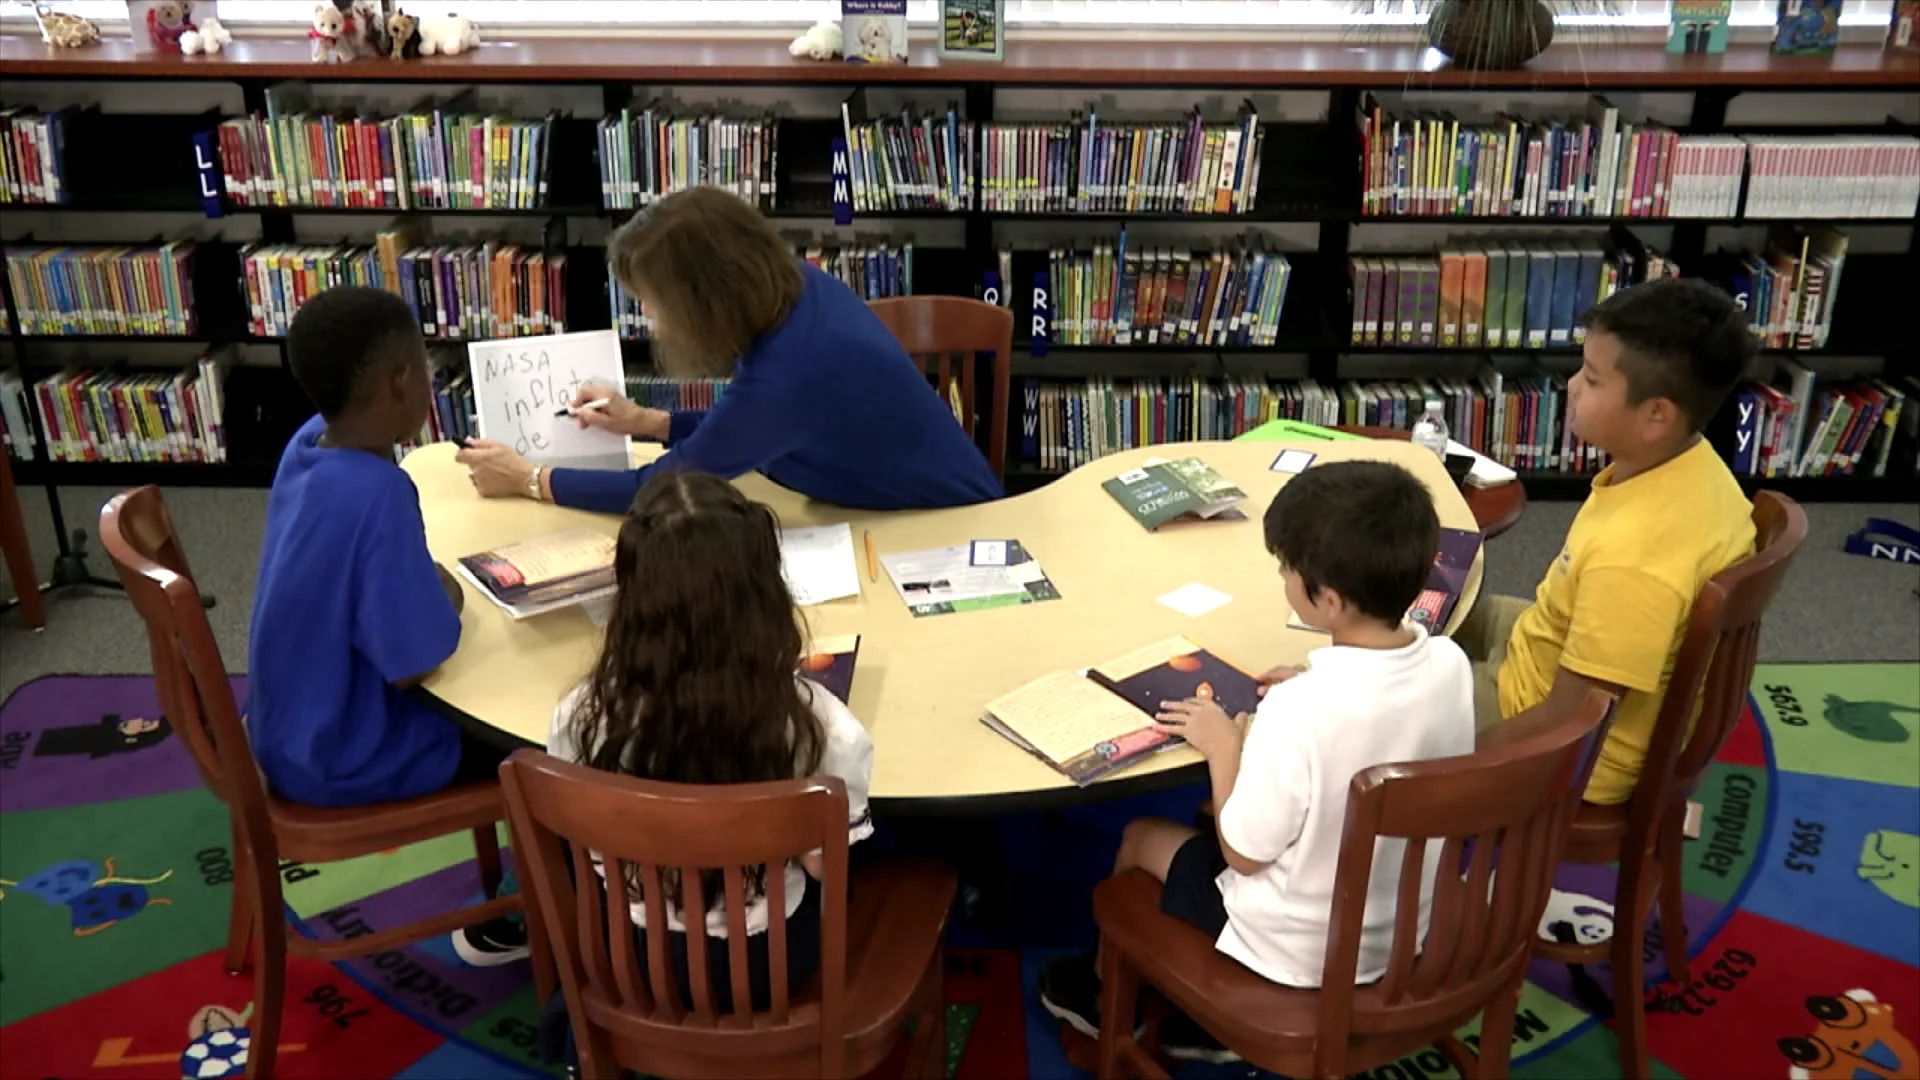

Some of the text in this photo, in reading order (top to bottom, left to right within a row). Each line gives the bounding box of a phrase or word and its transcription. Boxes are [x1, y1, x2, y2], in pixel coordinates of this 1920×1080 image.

[484, 350, 551, 383] NASA
[514, 421, 551, 457] de
[1698, 773, 1758, 879] Computer
